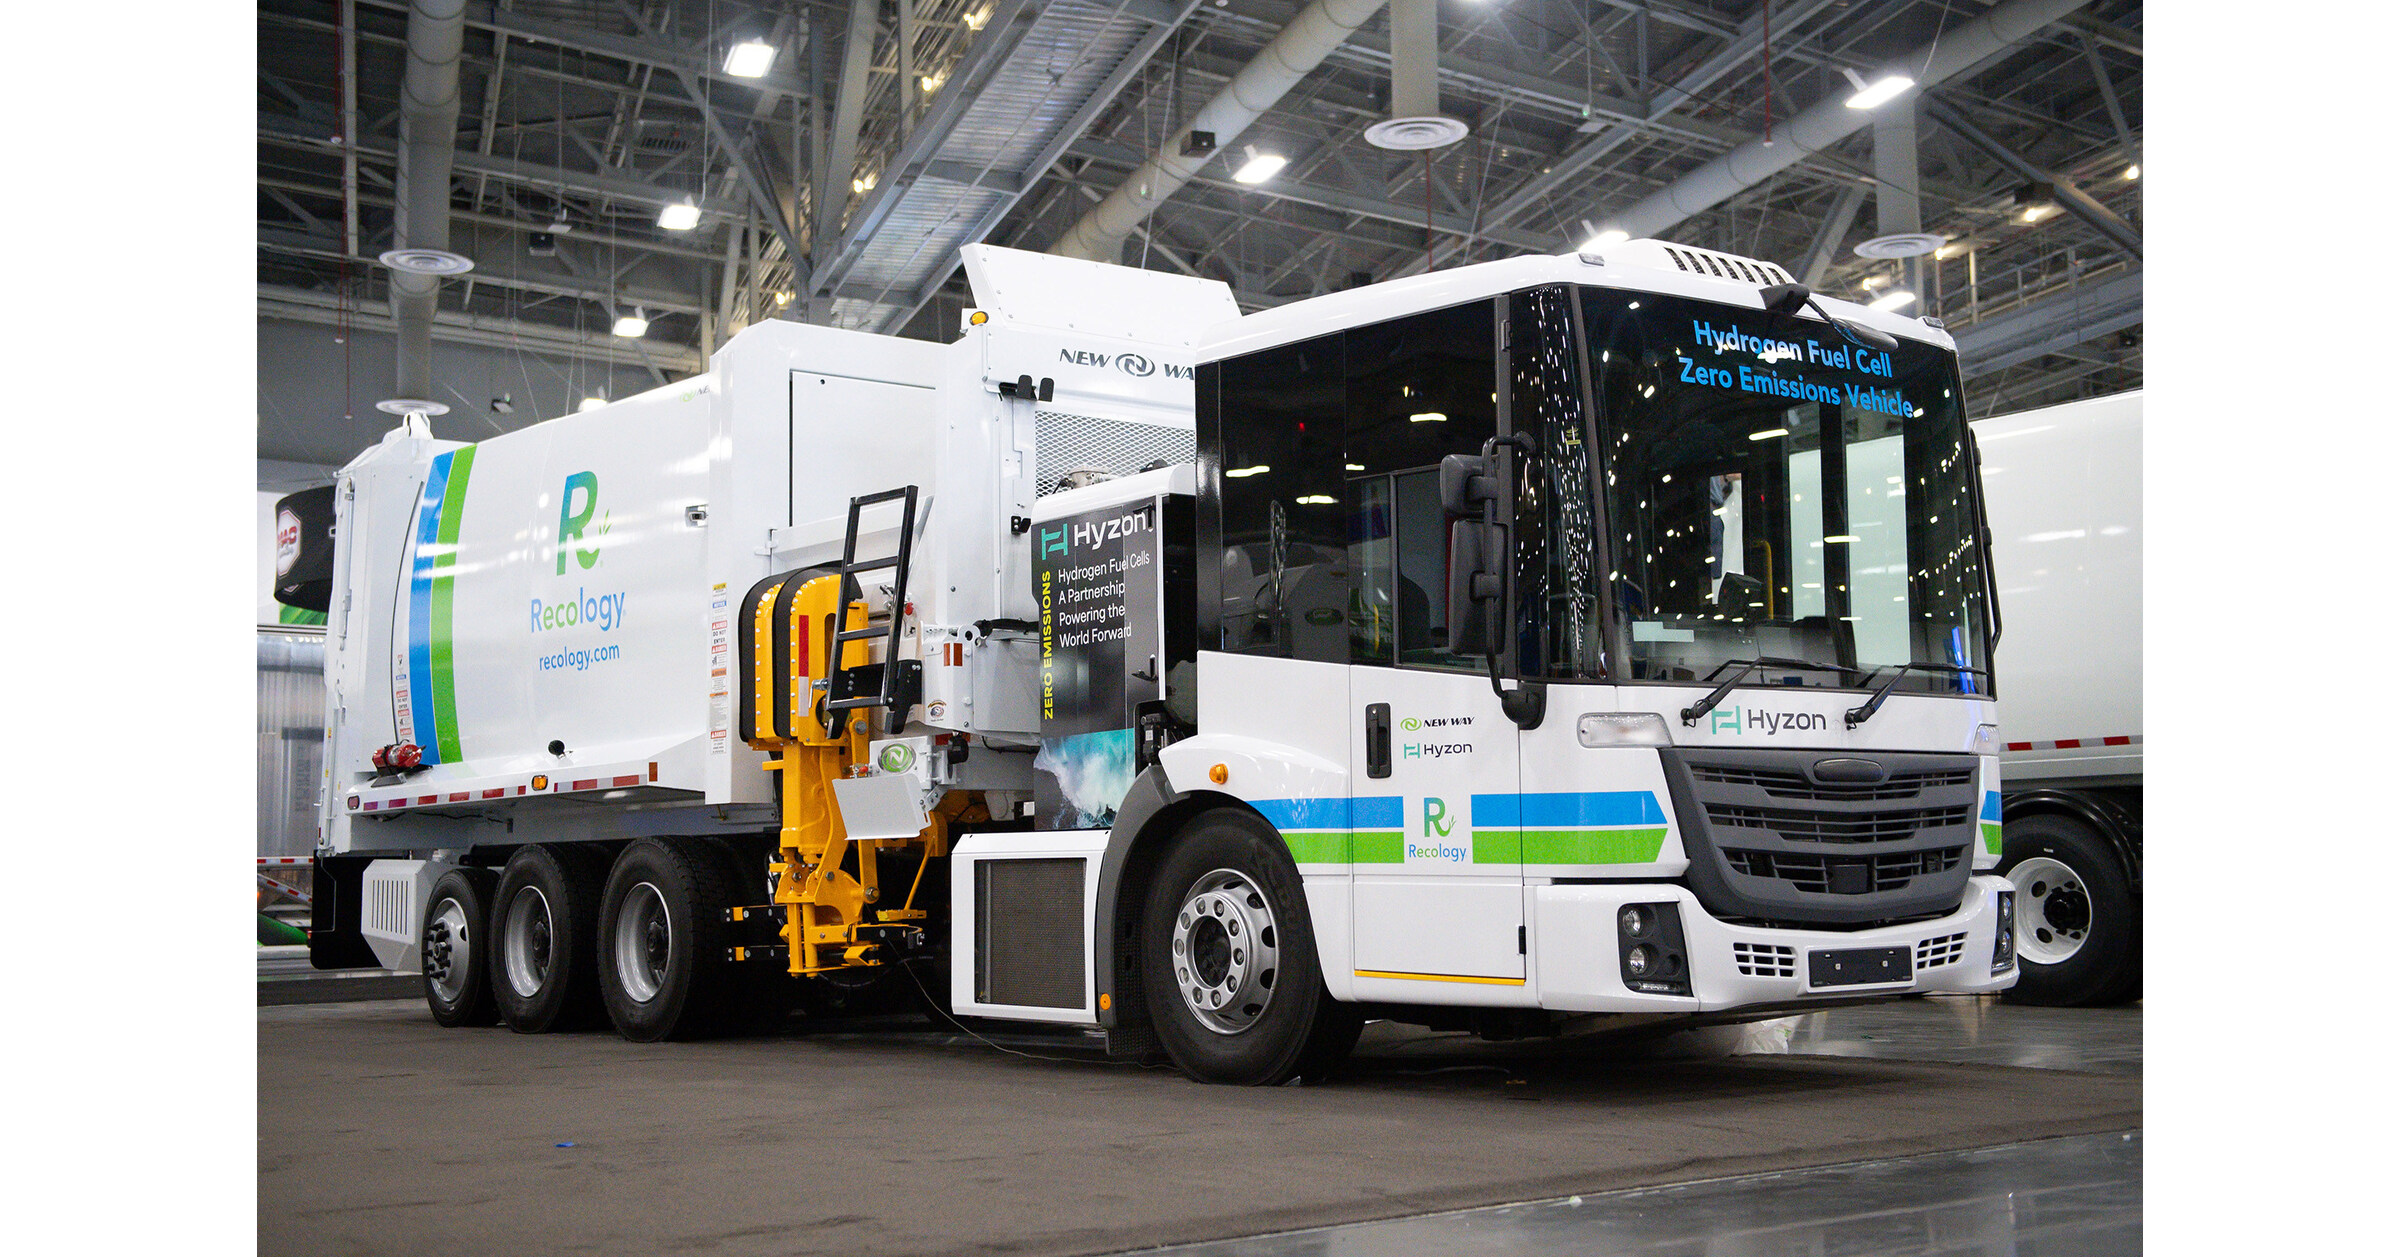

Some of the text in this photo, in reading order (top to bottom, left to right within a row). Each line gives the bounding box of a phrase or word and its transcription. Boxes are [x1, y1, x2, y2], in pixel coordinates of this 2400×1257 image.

[1693, 319, 1893, 378] Hydrogen Fuel Cell
[1060, 348, 1195, 381] NEW WA
[1678, 356, 1914, 418] Zero Emissions Vehicle
[1074, 511, 1147, 550] Hyzon
[1058, 549, 1150, 585] Hydrogen Fuel Cells
[1058, 580, 1126, 605] A Partnership
[531, 587, 625, 633] Recology
[1059, 603, 1126, 627] Powering the
[1042, 570, 1054, 720] ZERO EMISSIONS
[1059, 622, 1132, 648] World Forward
[539, 644, 620, 671] recology.com
[1423, 716, 1475, 728] NEW WAY
[1747, 708, 1827, 736] Hyzon
[1424, 743, 1473, 758] Hyzon
[1423, 796, 1452, 838] R
[1408, 842, 1467, 863] Recology
